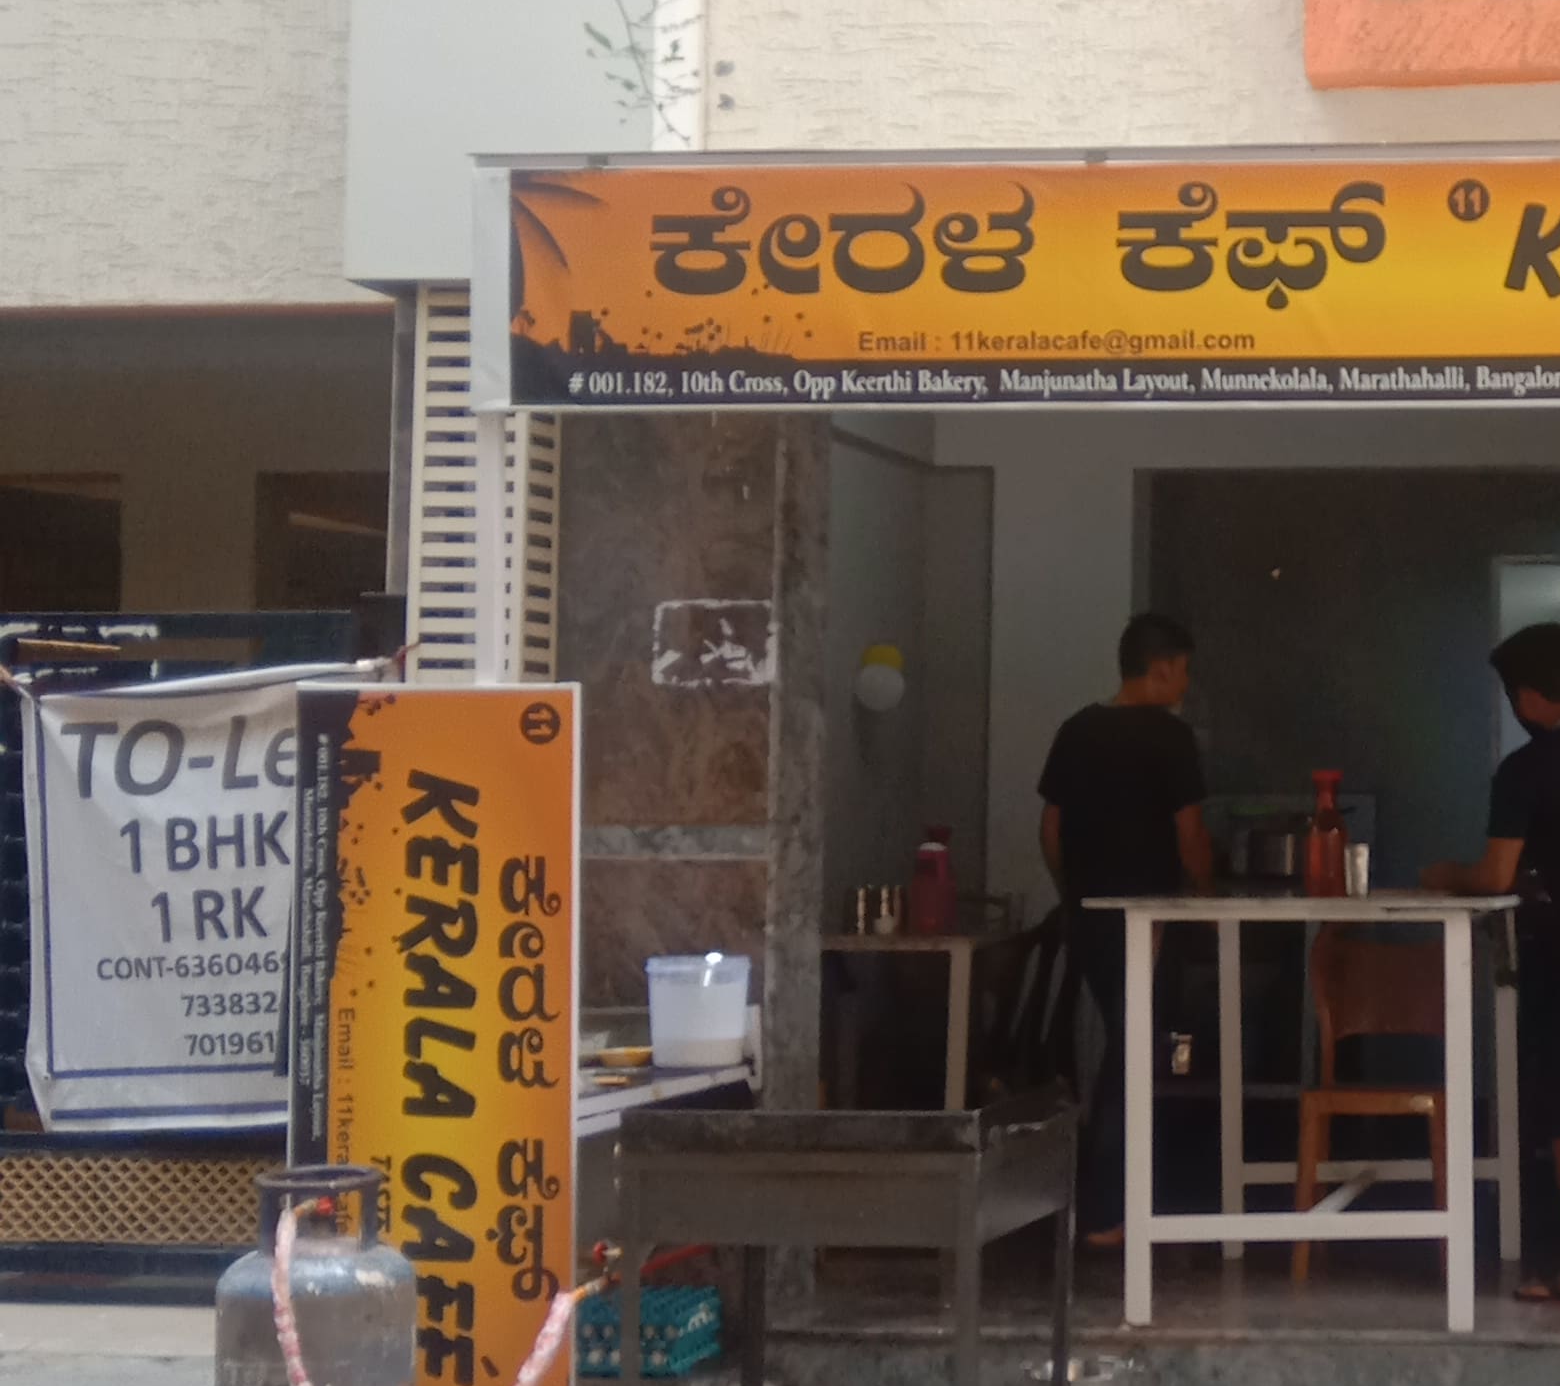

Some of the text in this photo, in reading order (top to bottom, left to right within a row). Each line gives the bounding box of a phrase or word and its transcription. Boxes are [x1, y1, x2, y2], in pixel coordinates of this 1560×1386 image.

[650, 181, 1035, 295] ಕೇರಳ
[859, 331, 926, 352] Email
[952, 329, 1255, 353] 11keralacafe@gmail.com
[681, 370, 723, 393] 10th
[729, 370, 788, 395] Cross,
[794, 369, 835, 399] Opp
[842, 369, 912, 393] Keerthi
[918, 369, 988, 400] Bakery,
[1000, 367, 1117, 398] Manjunatha
[1123, 367, 1195, 398] Layout,
[1201, 366, 1333, 395] Munnekolala,
[1339, 366, 1471, 392] Marathahalli,
[120, 811, 290, 874] 1 BHK
[151, 886, 268, 943] 1 RK
[97, 950, 286, 981] CONT-636046
[399, 769, 480, 1118] KERALA
[497, 855, 562, 1089] ಕೇರಳ
[181, 991, 278, 1017] 733832
[184, 1030, 276, 1057] 701961
[337, 1008, 356, 1071] Email
